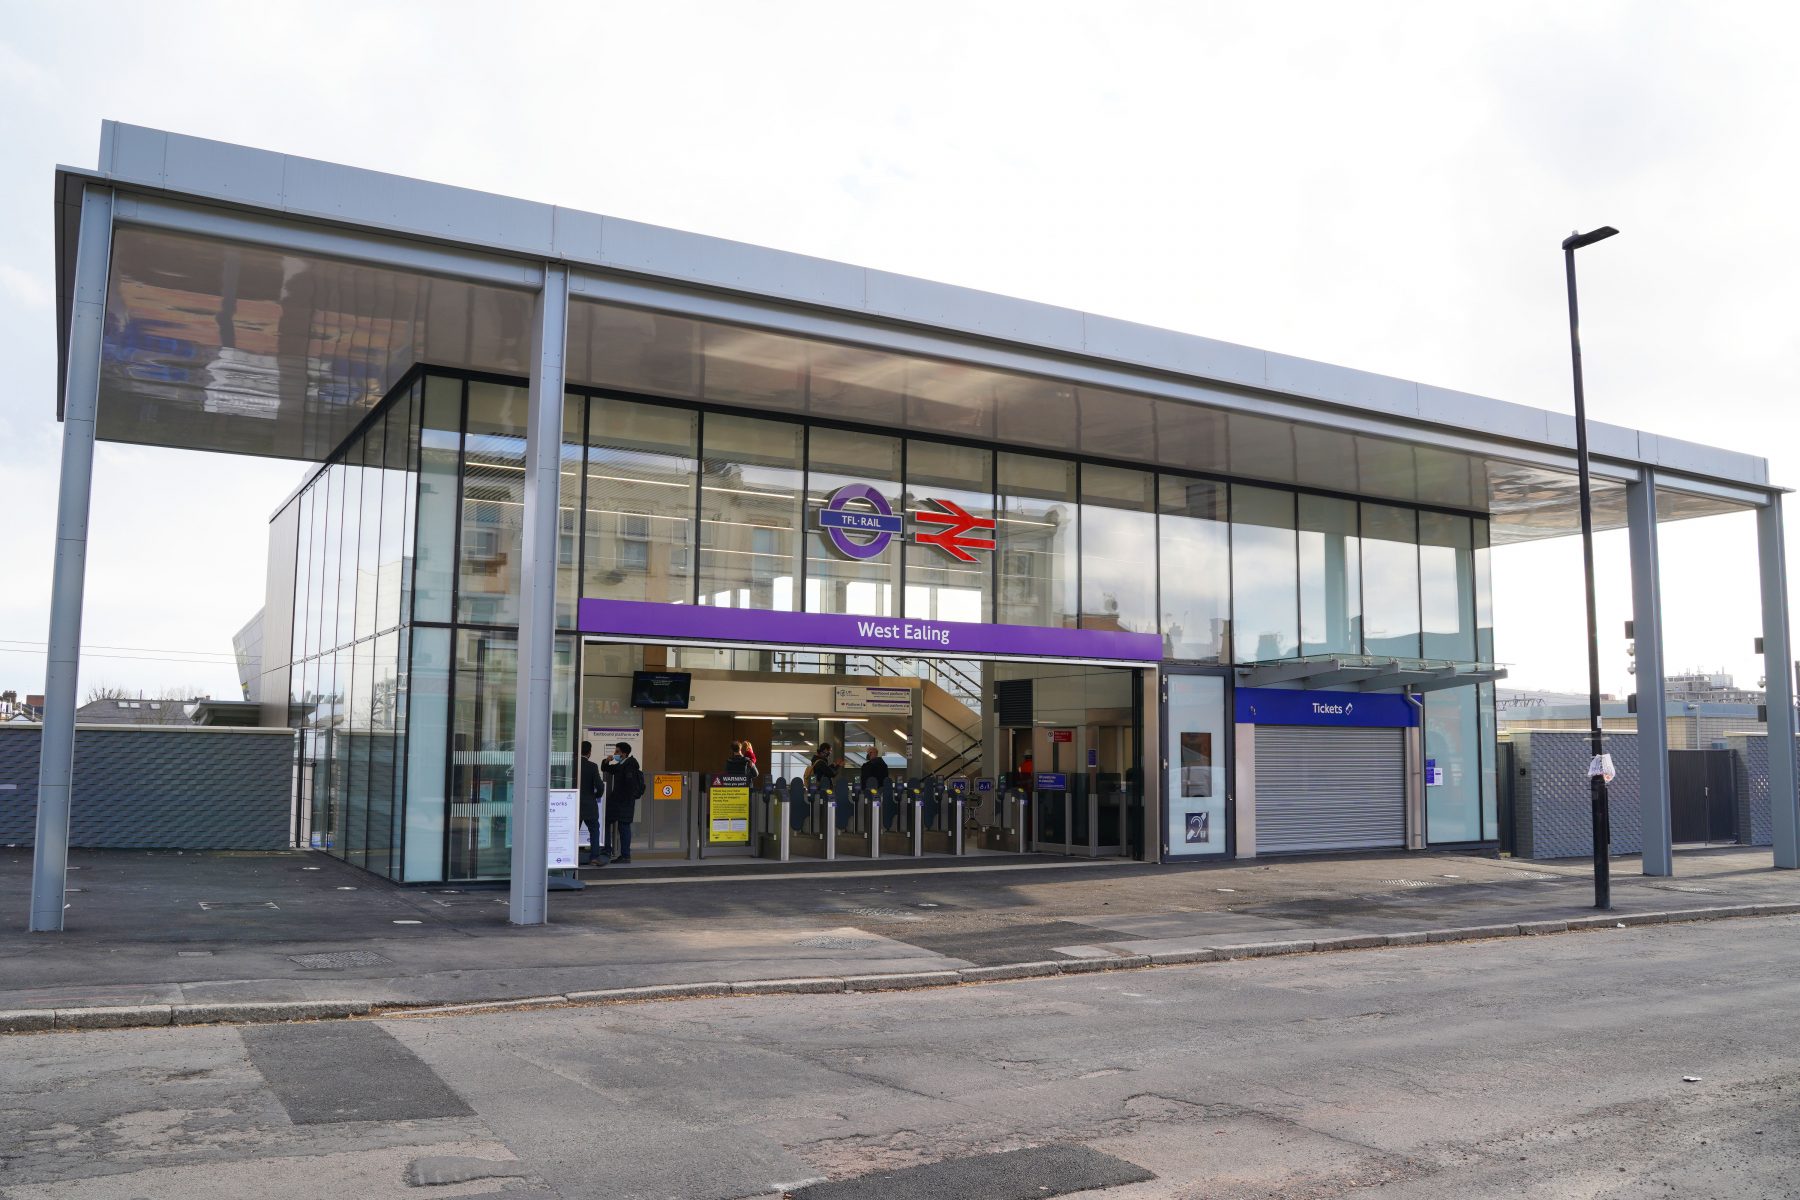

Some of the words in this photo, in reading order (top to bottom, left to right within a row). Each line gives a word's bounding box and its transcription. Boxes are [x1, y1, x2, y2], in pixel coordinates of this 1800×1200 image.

[857, 621, 900, 639] West
[904, 624, 950, 645] Ealing
[1312, 702, 1343, 714] Tickets
[665, 787, 671, 795] 3
